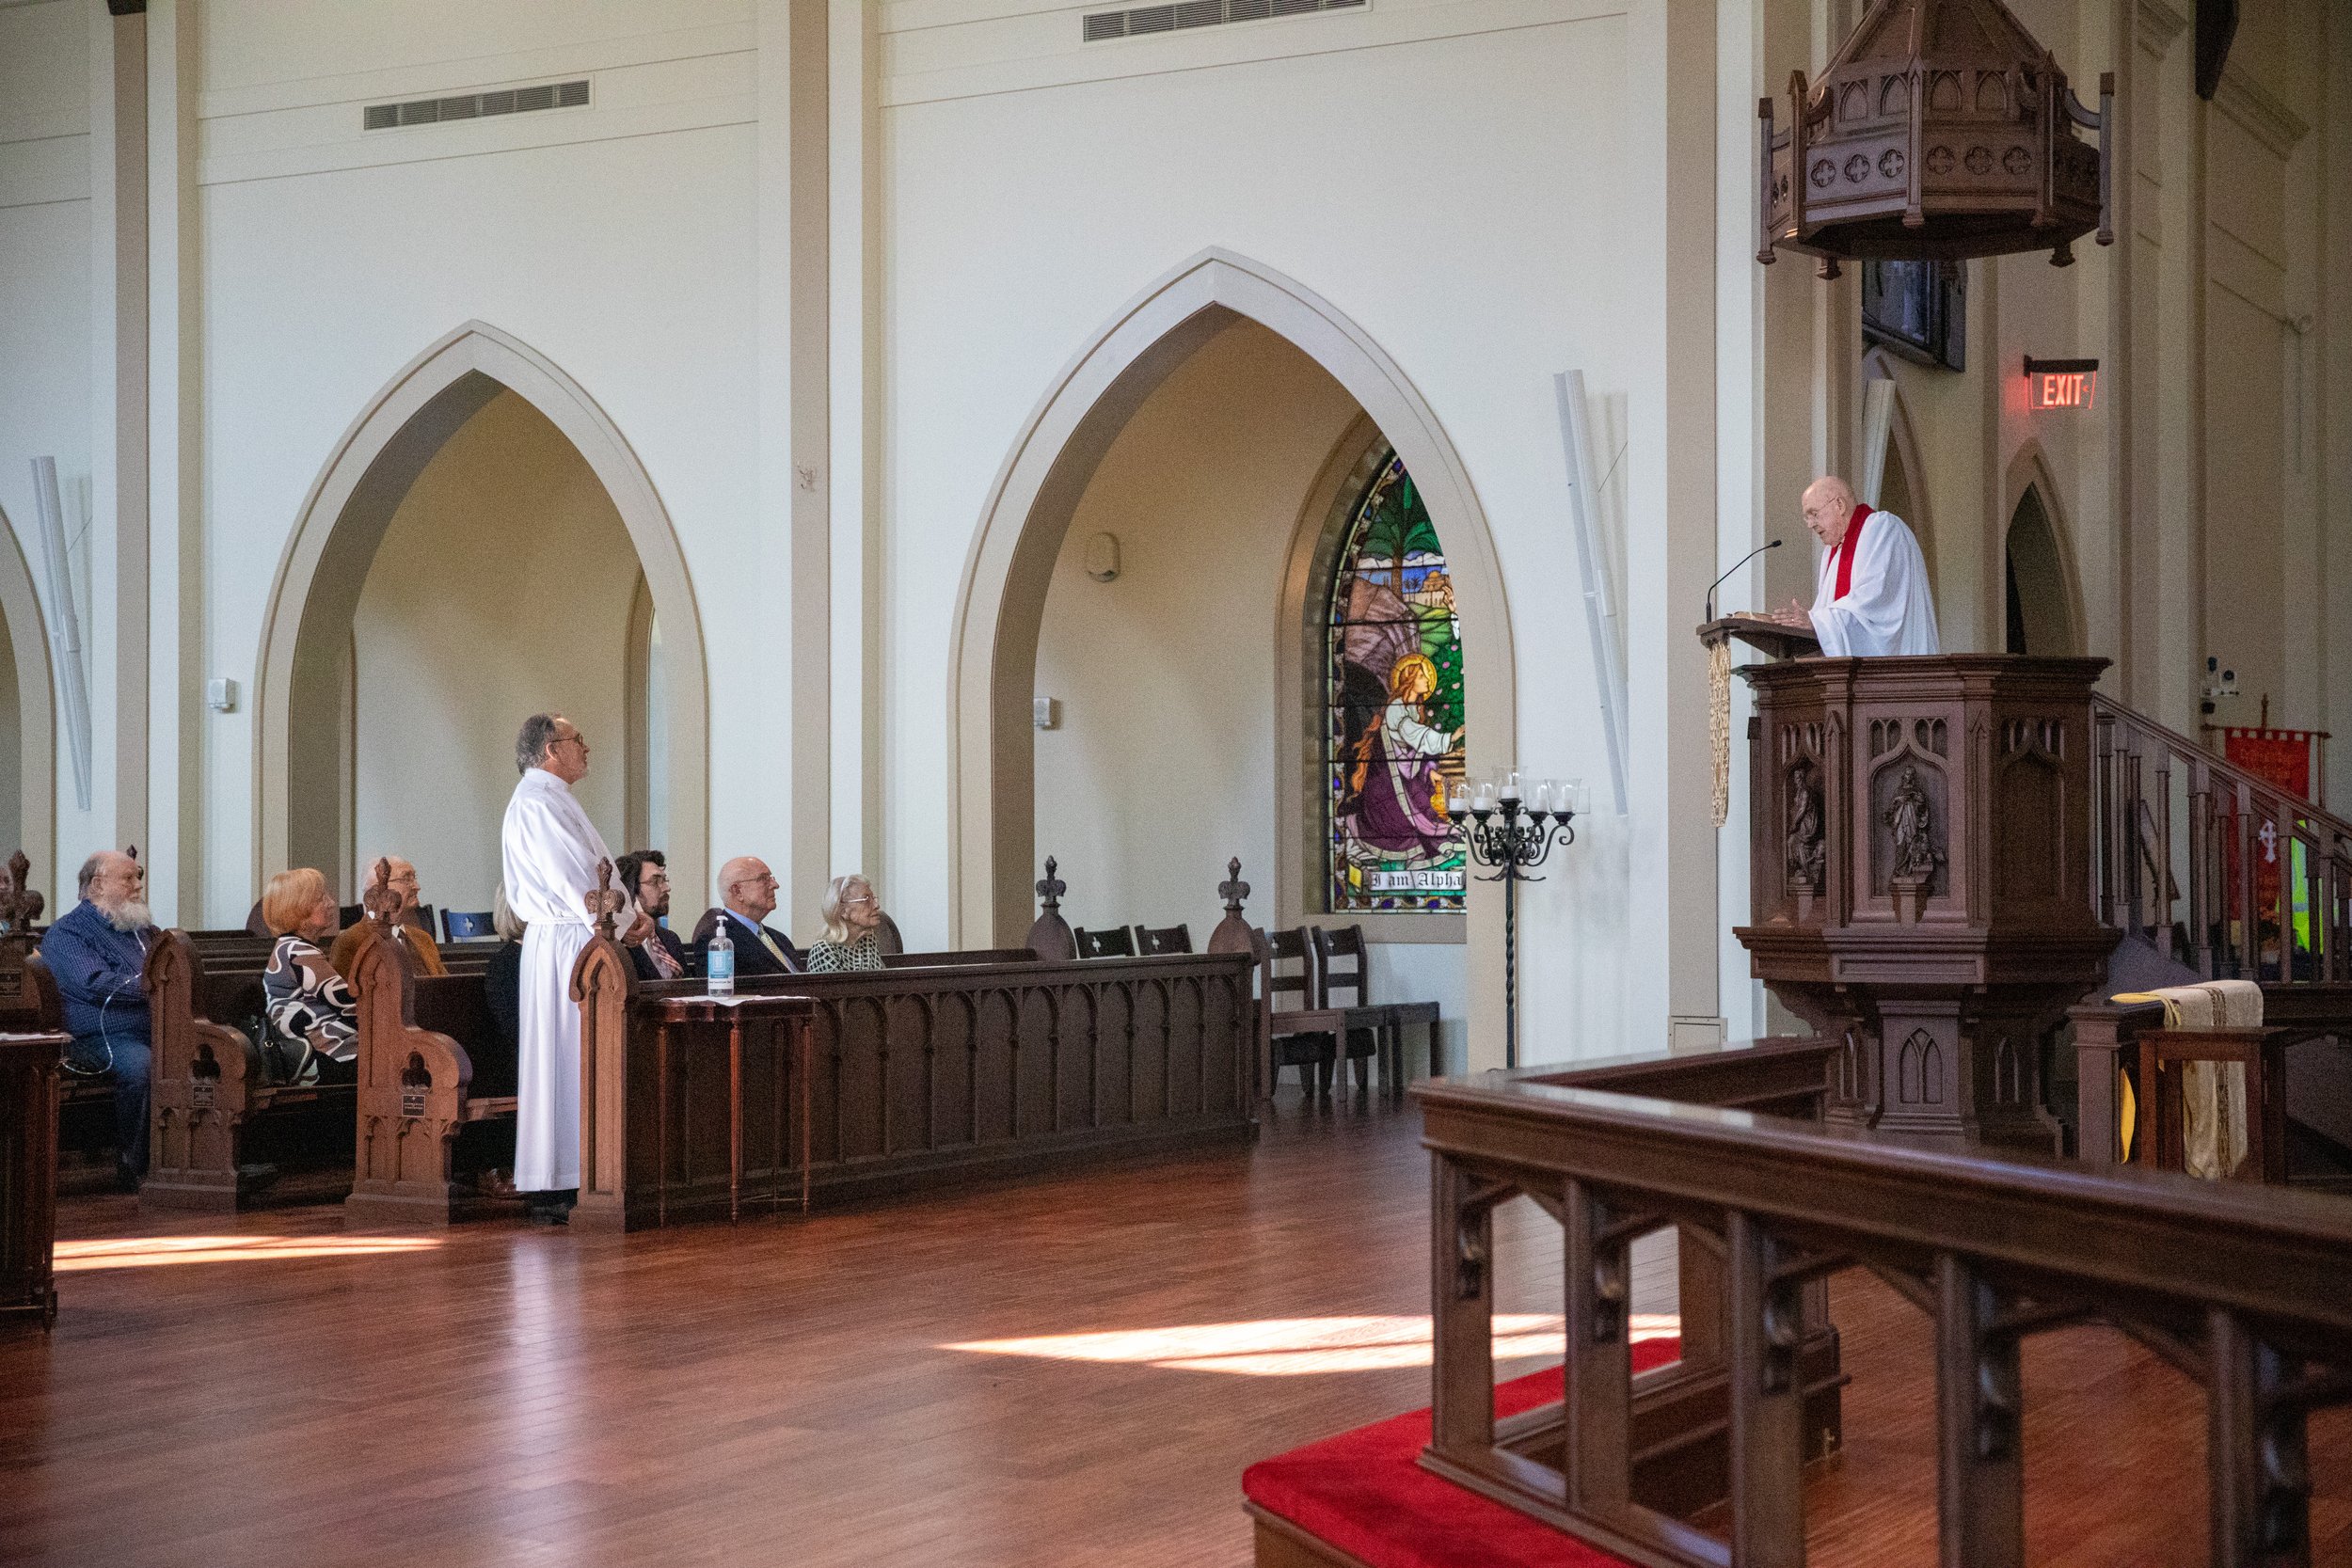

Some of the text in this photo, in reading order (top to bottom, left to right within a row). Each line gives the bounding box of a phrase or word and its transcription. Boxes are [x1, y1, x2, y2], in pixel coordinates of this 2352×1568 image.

[2042, 373, 2085, 405] EXIT
[1372, 872, 1461, 887] I am Alpha
